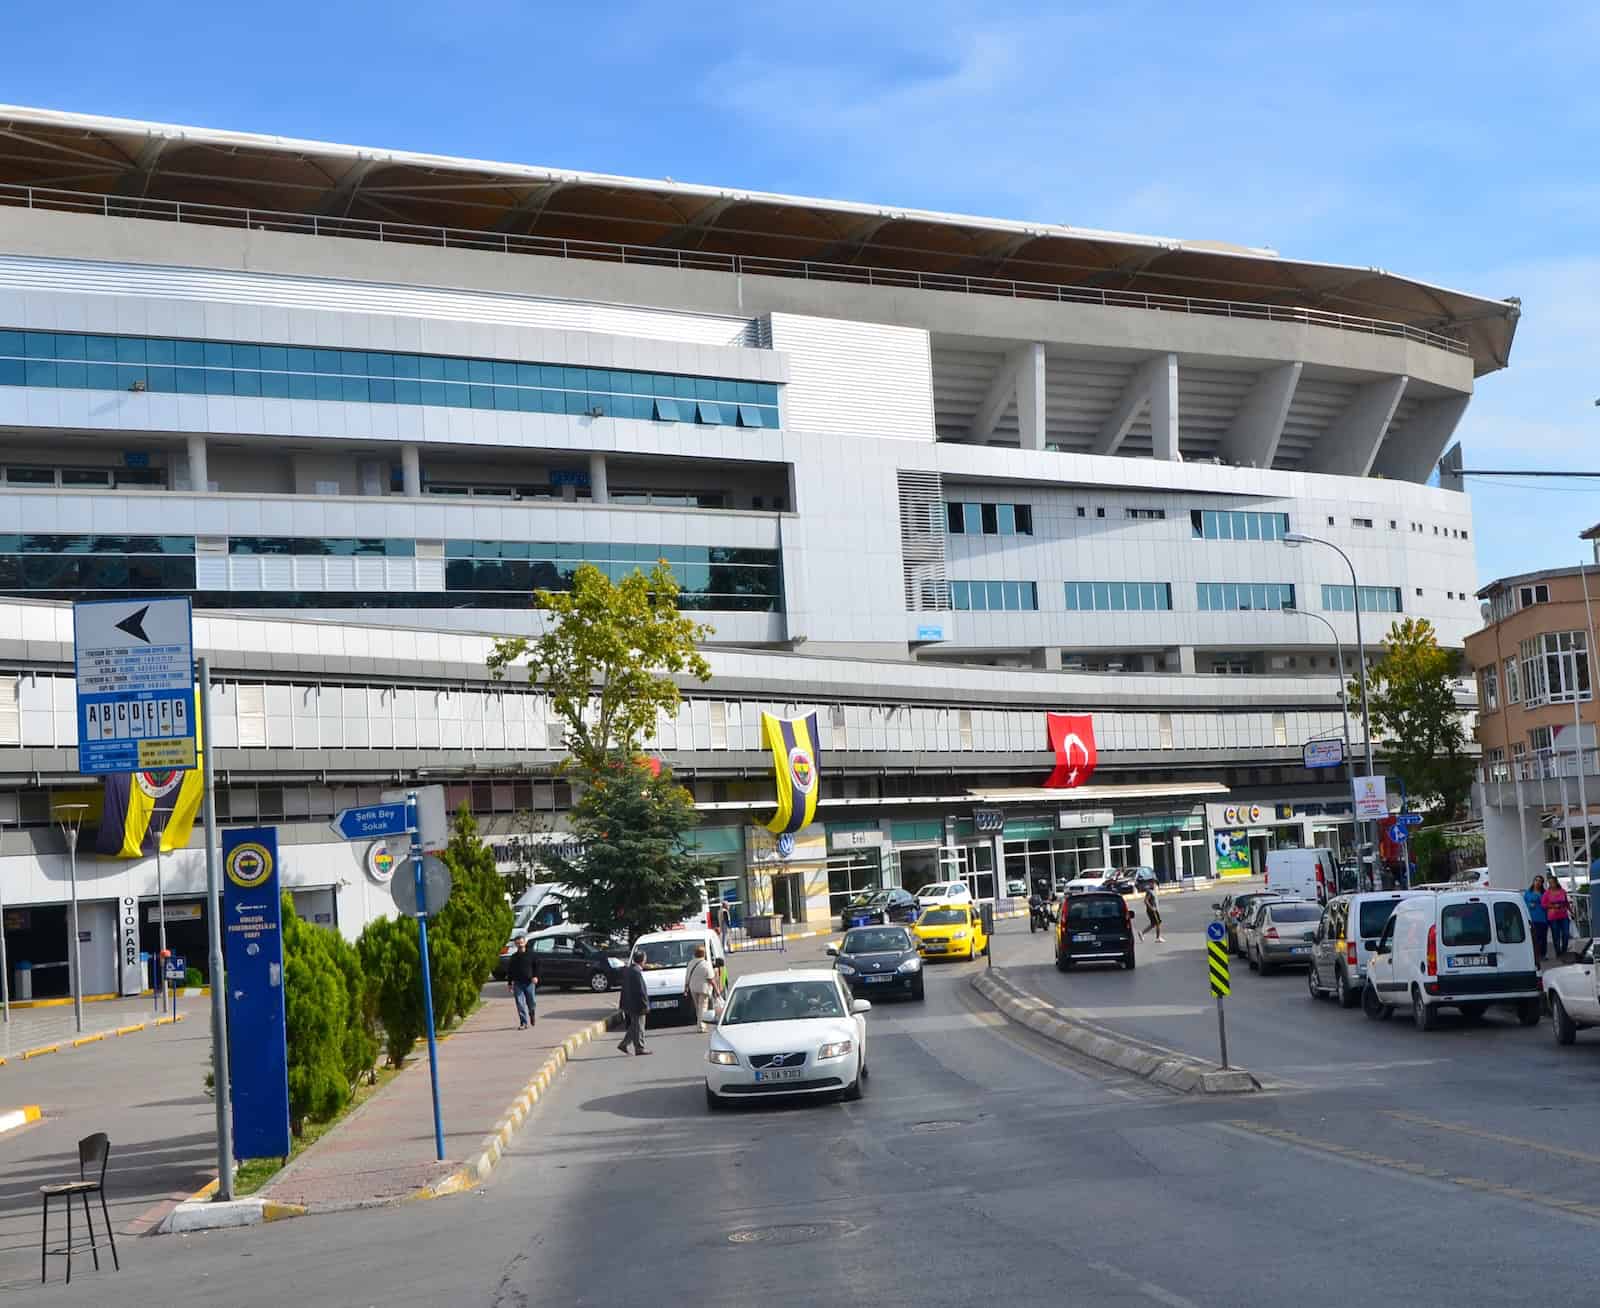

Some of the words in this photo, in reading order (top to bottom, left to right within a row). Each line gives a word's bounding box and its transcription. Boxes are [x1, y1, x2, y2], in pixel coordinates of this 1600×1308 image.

[89, 706, 97, 722] A
[103, 705, 111, 721] B
[118, 704, 126, 720] C
[132, 703, 140, 720] D
[147, 702, 154, 719] E
[161, 702, 168, 719] F
[176, 701, 183, 718] G
[361, 821, 389, 831] Sokak
